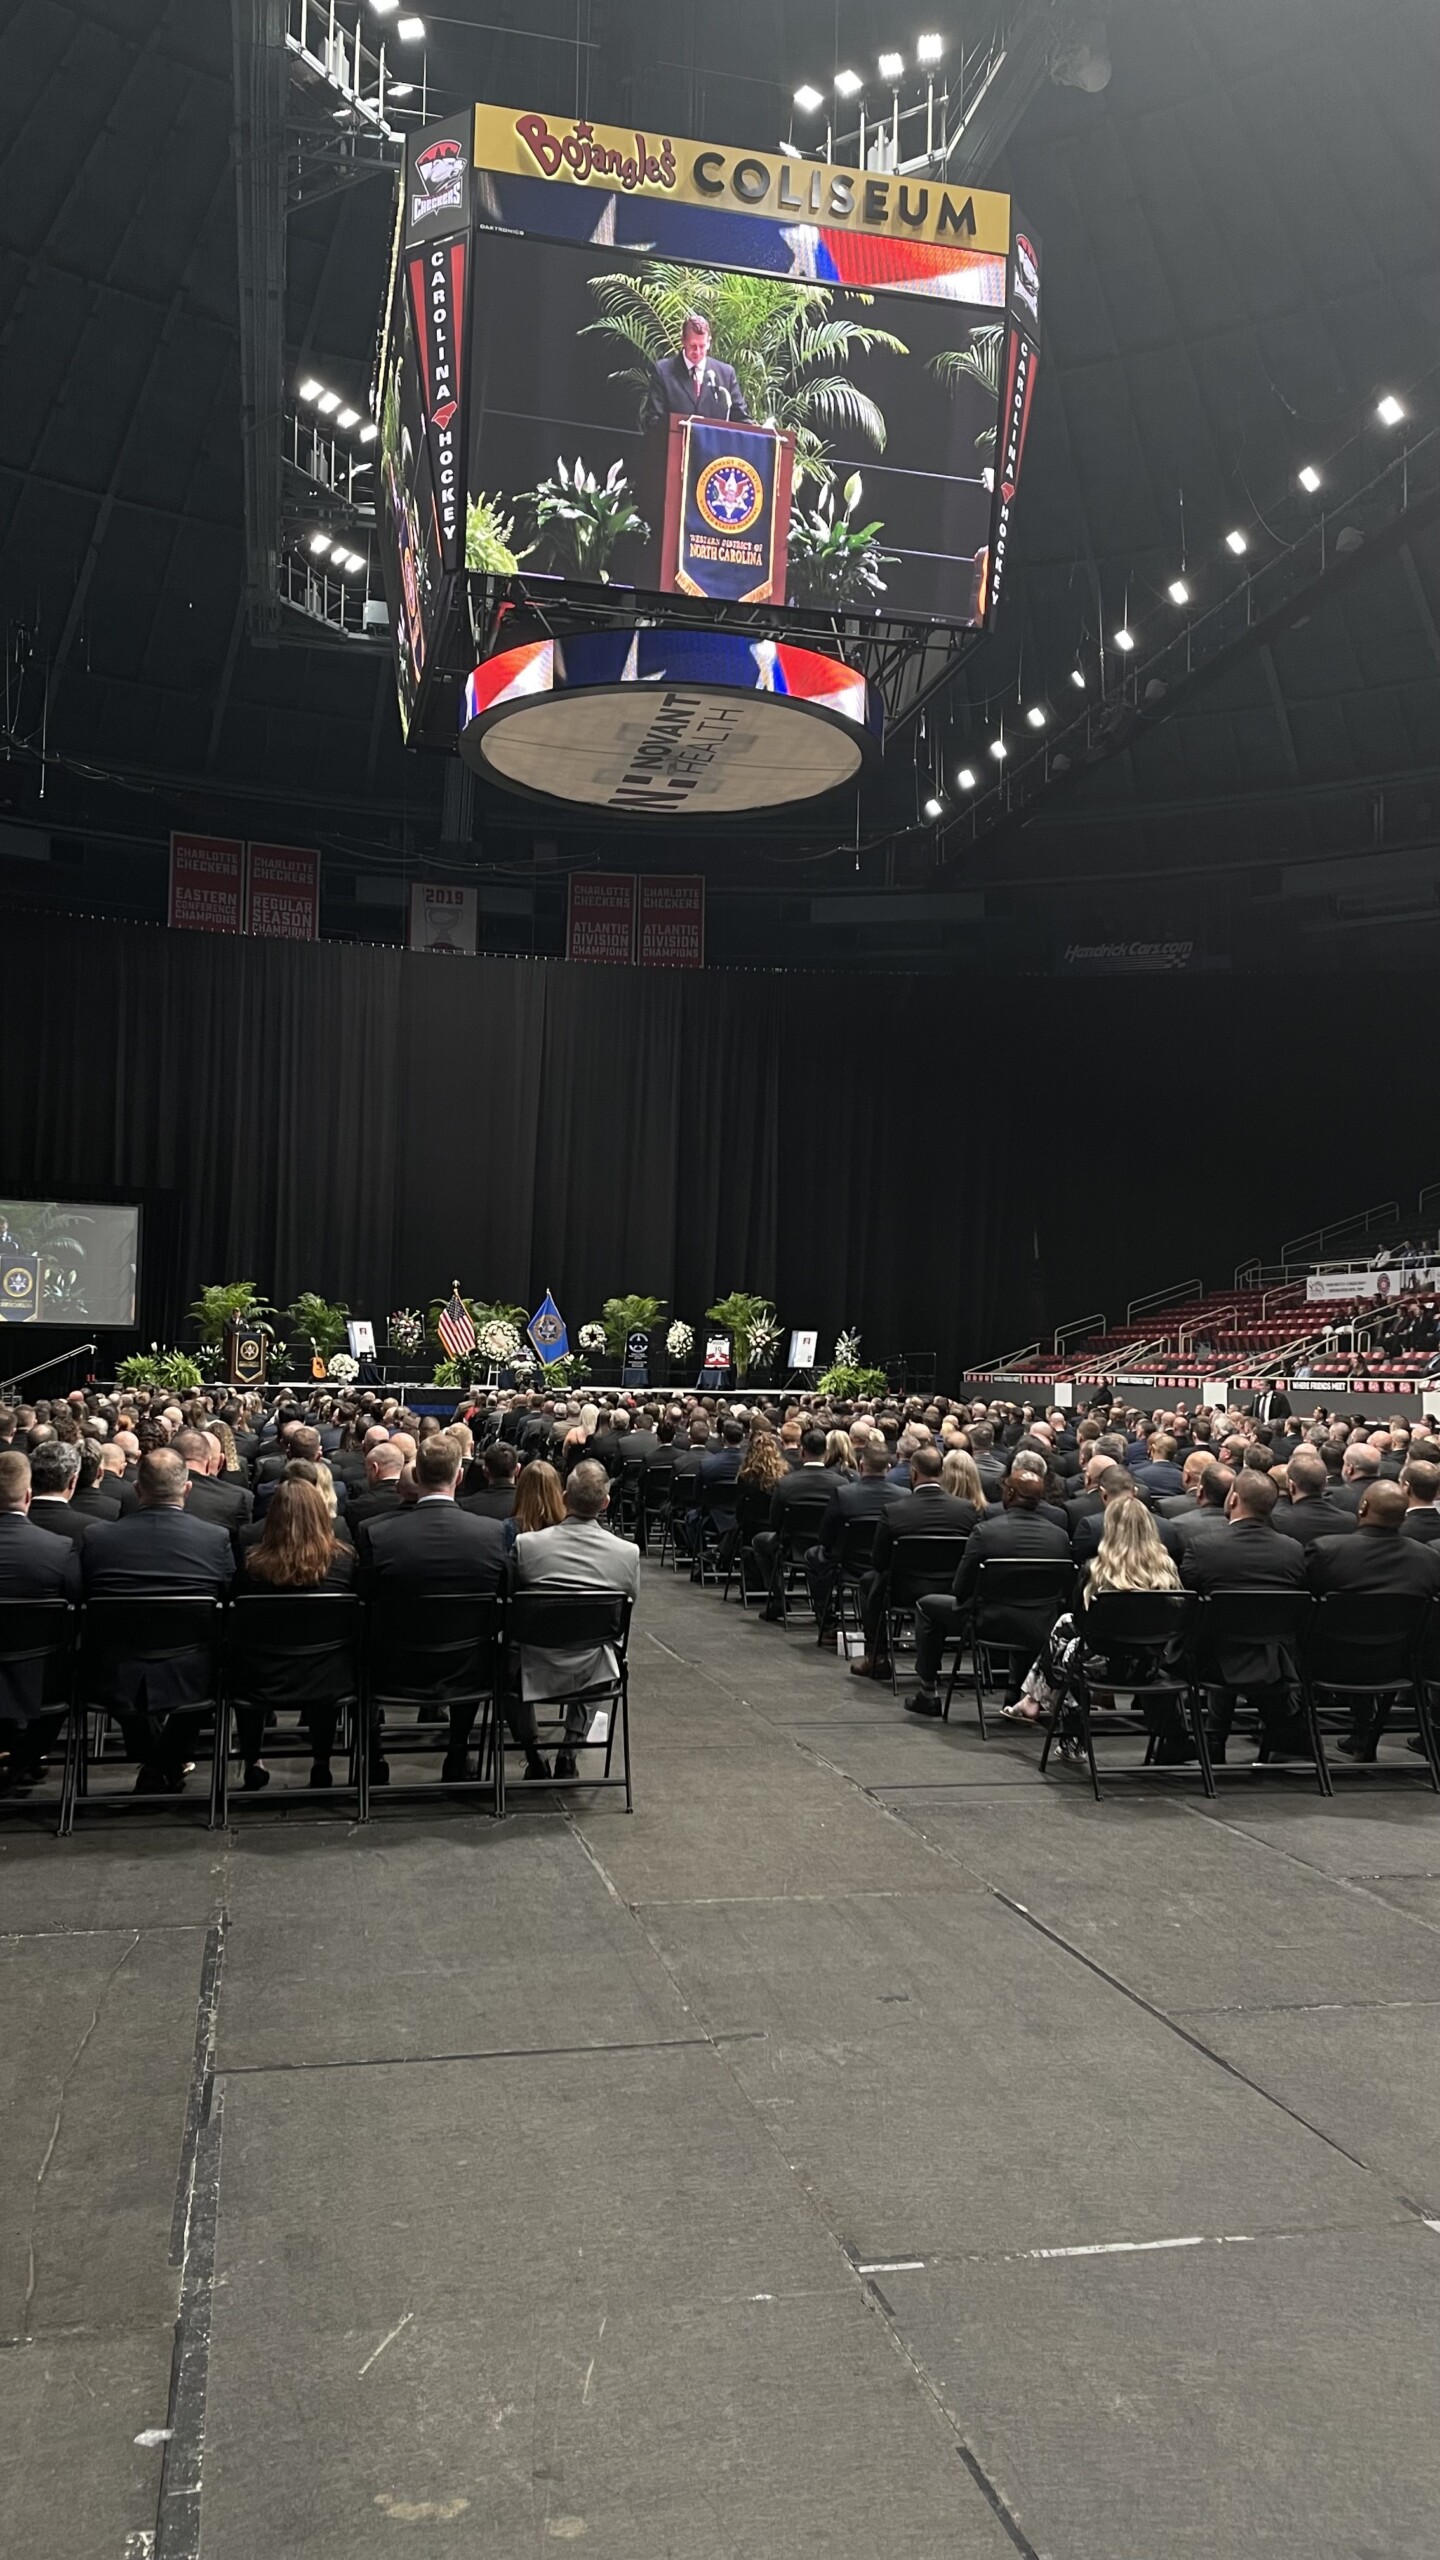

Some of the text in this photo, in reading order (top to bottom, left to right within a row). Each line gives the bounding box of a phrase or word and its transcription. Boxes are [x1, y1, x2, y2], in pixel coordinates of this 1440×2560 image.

[414, 181, 461, 220] CHECKERS
[693, 152, 977, 236] COLISEUM
[480, 224, 524, 236] DAKTRONICS
[431, 251, 456, 541] CAROLINA HOCKEY
[1005, 342, 1028, 479] CAROLINA
[690, 534, 720, 546] WESTERN
[722, 538, 752, 551] DISTRICT
[690, 543, 763, 566] NORTH CAROLINA
[992, 504, 1010, 606] HOCKEY
[630, 692, 701, 770] NOVANT
[675, 707, 744, 775] HEALTH
[176, 847, 238, 865] CHARLOTTE
[253, 856, 314, 873] CHARLOTTE
[176, 858, 238, 876] CHECKERS
[253, 867, 314, 885] CHECKERS
[175, 886, 237, 906] EASTERN
[425, 887, 464, 905] 2019
[574, 884, 630, 897] CHARLOTTE
[643, 887, 700, 899] CHARLOTTE
[175, 899, 237, 915] CONFERENCE
[253, 896, 312, 914] REGULAR
[573, 895, 630, 909] CHECKERS
[643, 896, 699, 910] CHECKERS
[175, 909, 236, 925] CHAMPIONS
[252, 908, 312, 928] SEASON
[252, 922, 312, 938] CHAMPIONS
[573, 922, 629, 935] ATLANTIC
[643, 923, 699, 936] ATLANTIC
[572, 933, 629, 946] DIVISION
[643, 934, 699, 948] DIVISION
[572, 945, 629, 958] CHAMPIONS
[642, 946, 699, 959] CHAMPIONS
